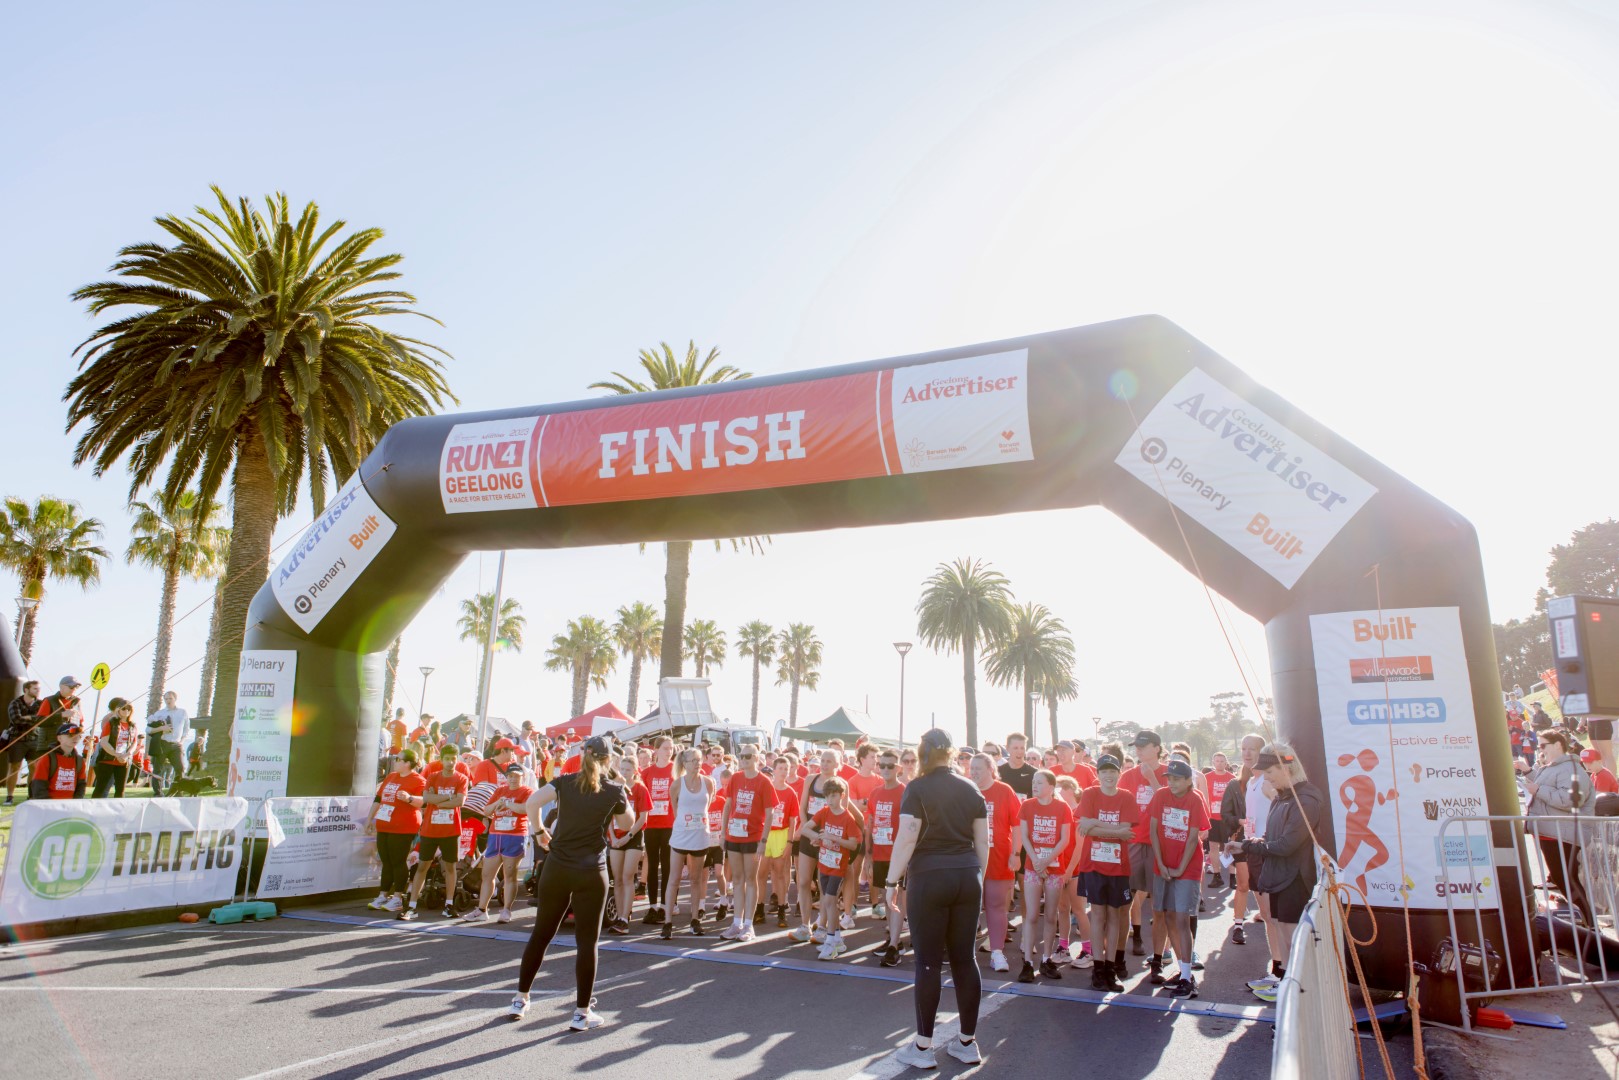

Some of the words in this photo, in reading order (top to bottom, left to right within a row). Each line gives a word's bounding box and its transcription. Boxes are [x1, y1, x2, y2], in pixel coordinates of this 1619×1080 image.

[901, 376, 1018, 404] Advertiser
[931, 376, 969, 386] Geelong
[1230, 408, 1287, 452] Geelong
[598, 409, 807, 479] FINISH
[1173, 392, 1348, 513] Advertiser
[446, 440, 525, 473] RUN4
[445, 472, 523, 494] GEELONG
[1165, 456, 1232, 512] Plenary
[481, 494, 503, 502] BETTER
[504, 492, 526, 500] HEALTH
[279, 486, 358, 588] Advertiser
[348, 514, 380, 551] Built
[1245, 511, 1304, 560] Built
[308, 557, 346, 598] Plenary
[1352, 616, 1417, 642] Built
[248, 658, 285, 672] Plenary
[1363, 656, 1421, 677] villawood
[1392, 735, 1438, 746] active
[1443, 735, 1473, 745] feet
[246, 754, 283, 762] Harcourts
[1426, 767, 1477, 778] ProFeet
[1440, 808, 1477, 817] PONDS
[1441, 797, 1482, 808] WAURN
[284, 828, 305, 836] REAT
[307, 824, 358, 834] MEMBERSHIP.
[307, 815, 351, 824] LOCATIONS
[1033, 818, 1057, 827] RUN4
[37, 833, 92, 884] GO
[112, 828, 236, 877] TRAFFIC
[1371, 881, 1396, 893] wcig
